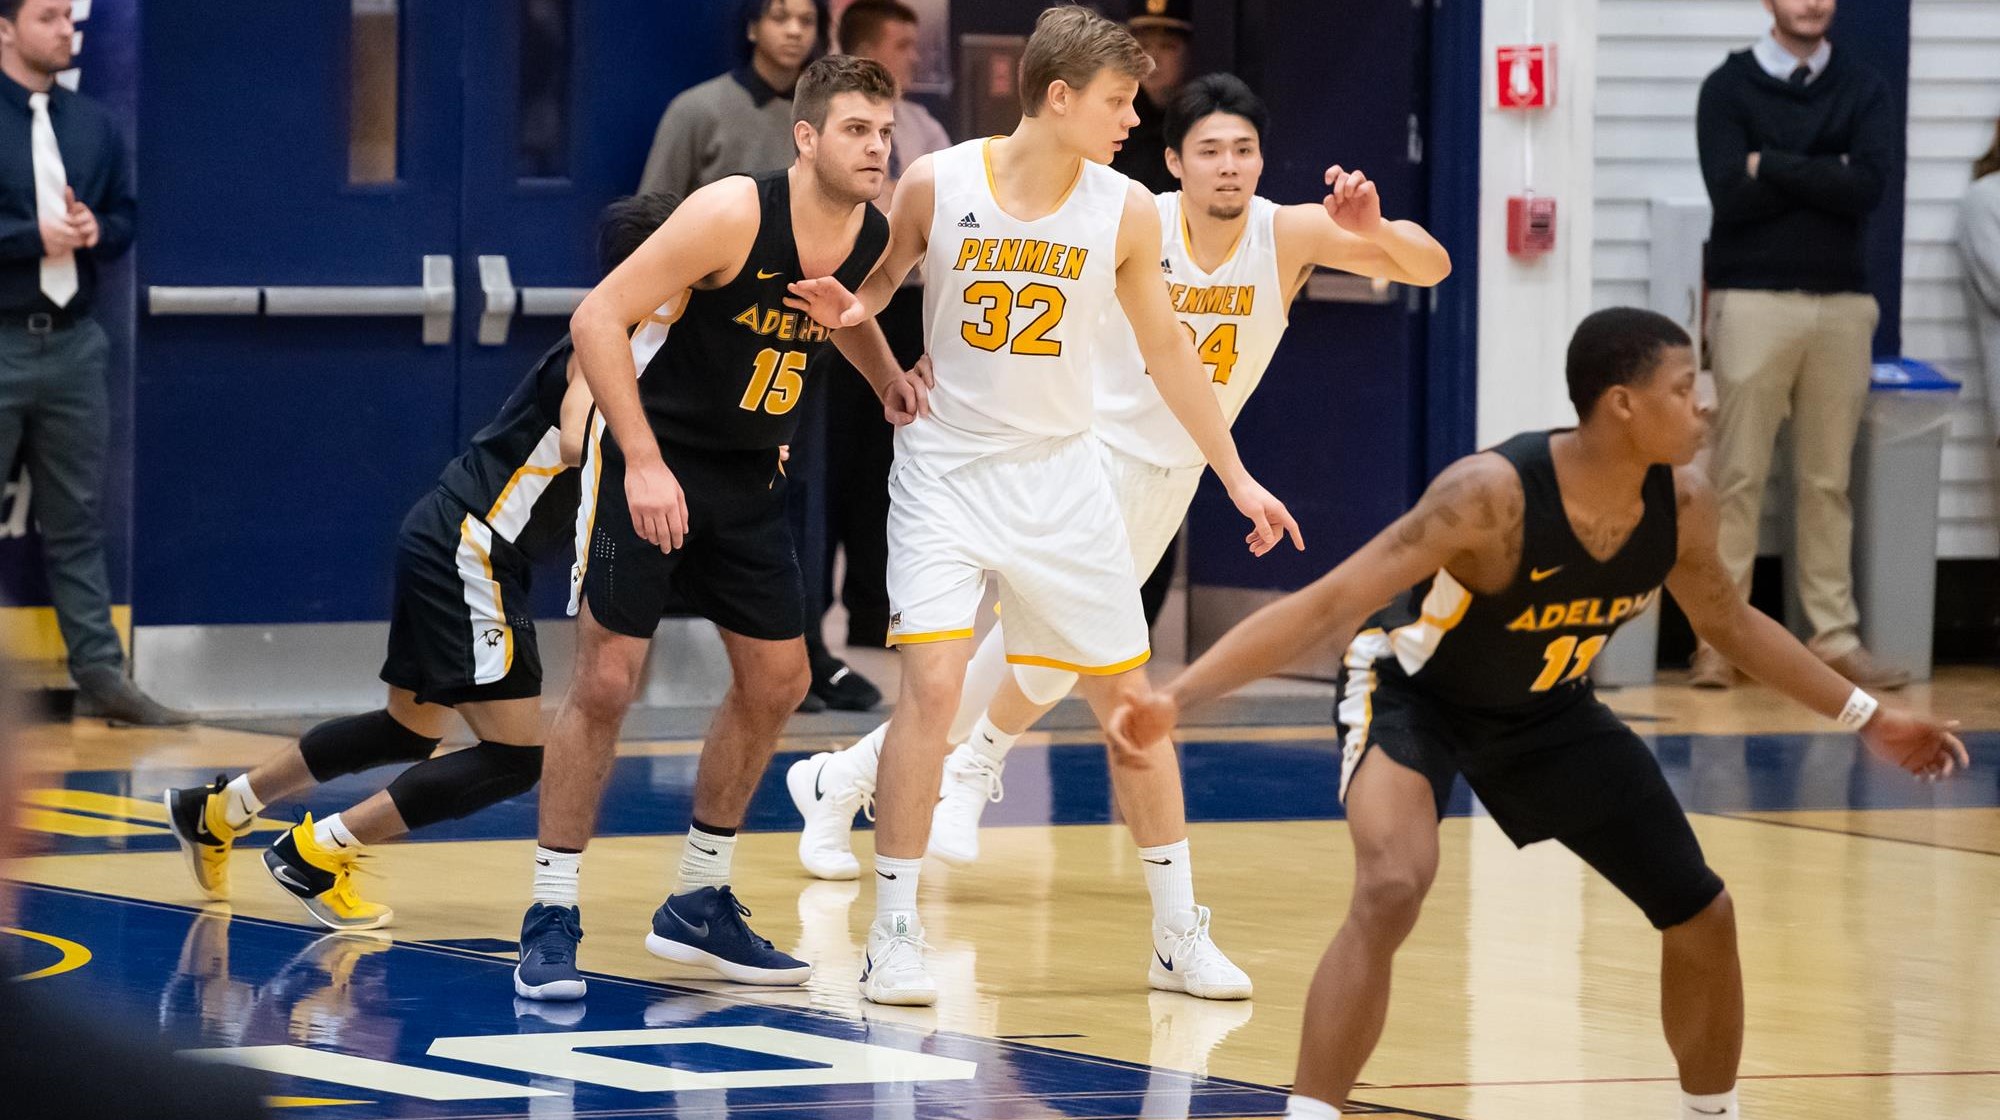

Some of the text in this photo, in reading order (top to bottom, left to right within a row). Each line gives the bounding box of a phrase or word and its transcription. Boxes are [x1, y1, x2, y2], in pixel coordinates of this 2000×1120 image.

[957, 221, 980, 229] adidas
[953, 237, 1089, 281] PENMEN
[960, 280, 1067, 357] 32
[1165, 281, 1255, 316] ENMEN
[1178, 320, 1239, 385] 4
[739, 347, 807, 415] 15
[1505, 585, 1661, 632] ADELPH
[1530, 634, 1608, 692] 11
